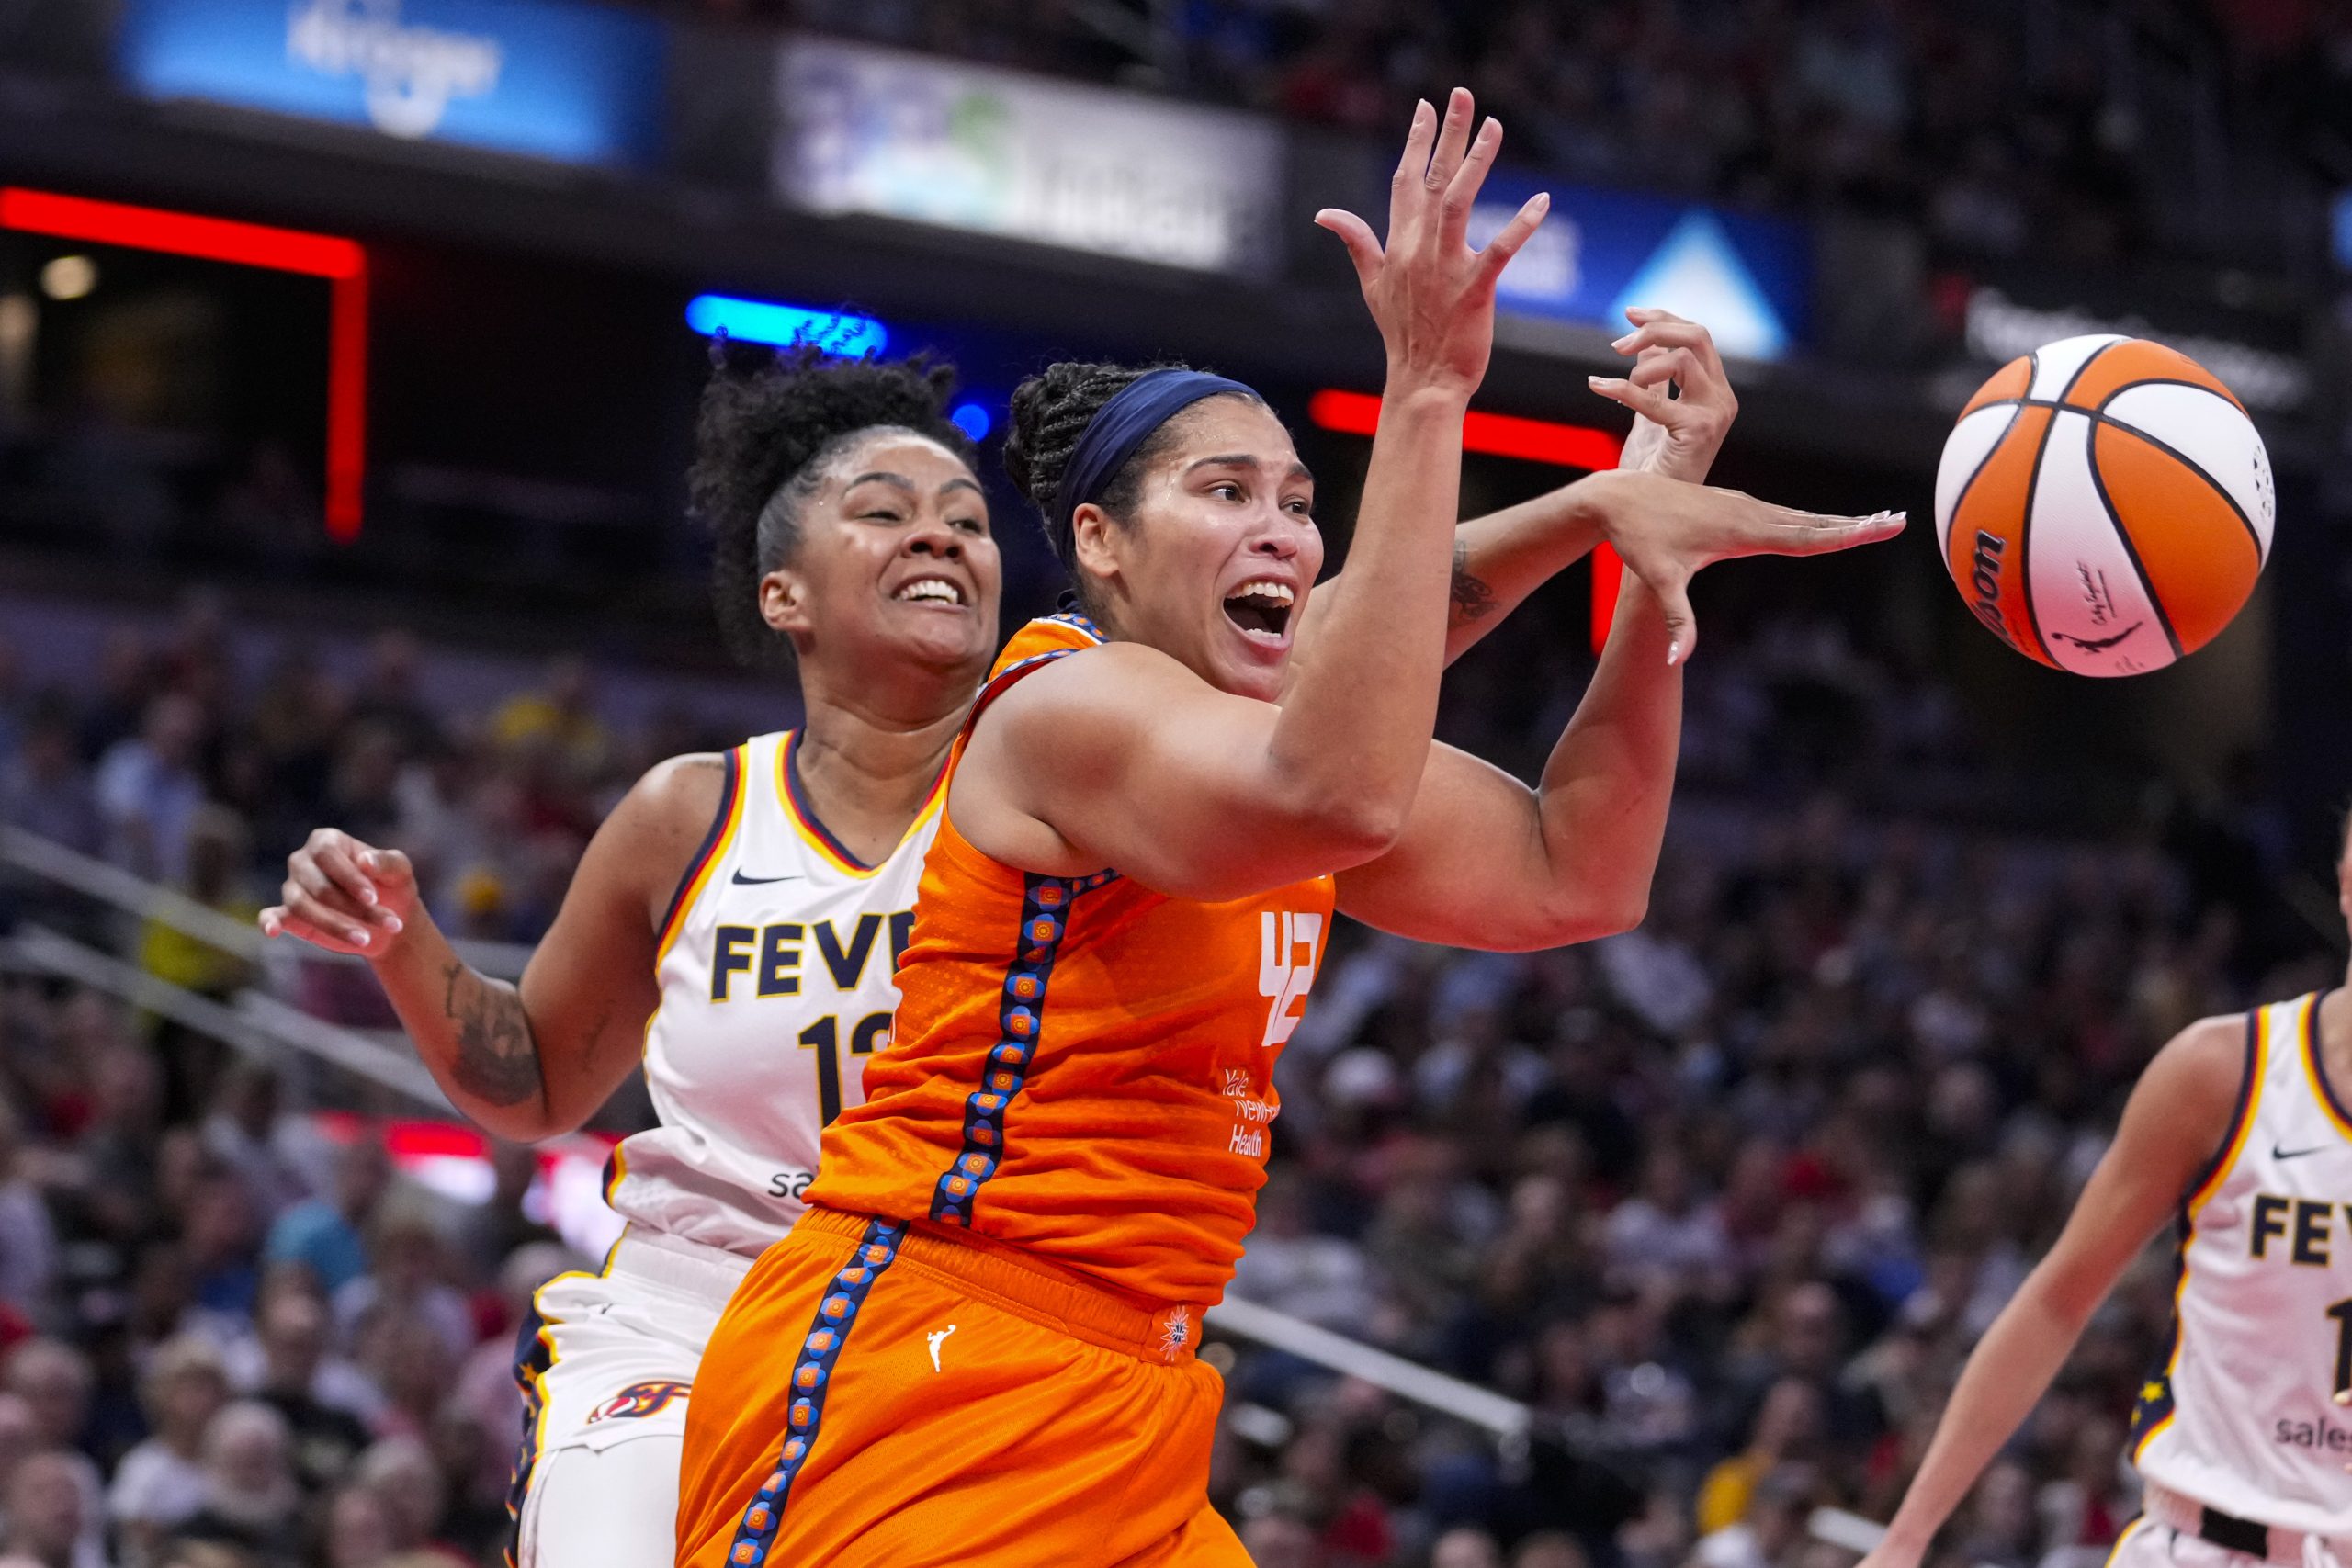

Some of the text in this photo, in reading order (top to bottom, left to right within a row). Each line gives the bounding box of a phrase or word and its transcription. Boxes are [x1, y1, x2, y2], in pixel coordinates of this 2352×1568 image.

[1258, 910, 1323, 1047] 42
[1222, 1068, 1249, 1097] Yale
[1228, 1123, 1261, 1157] Health
